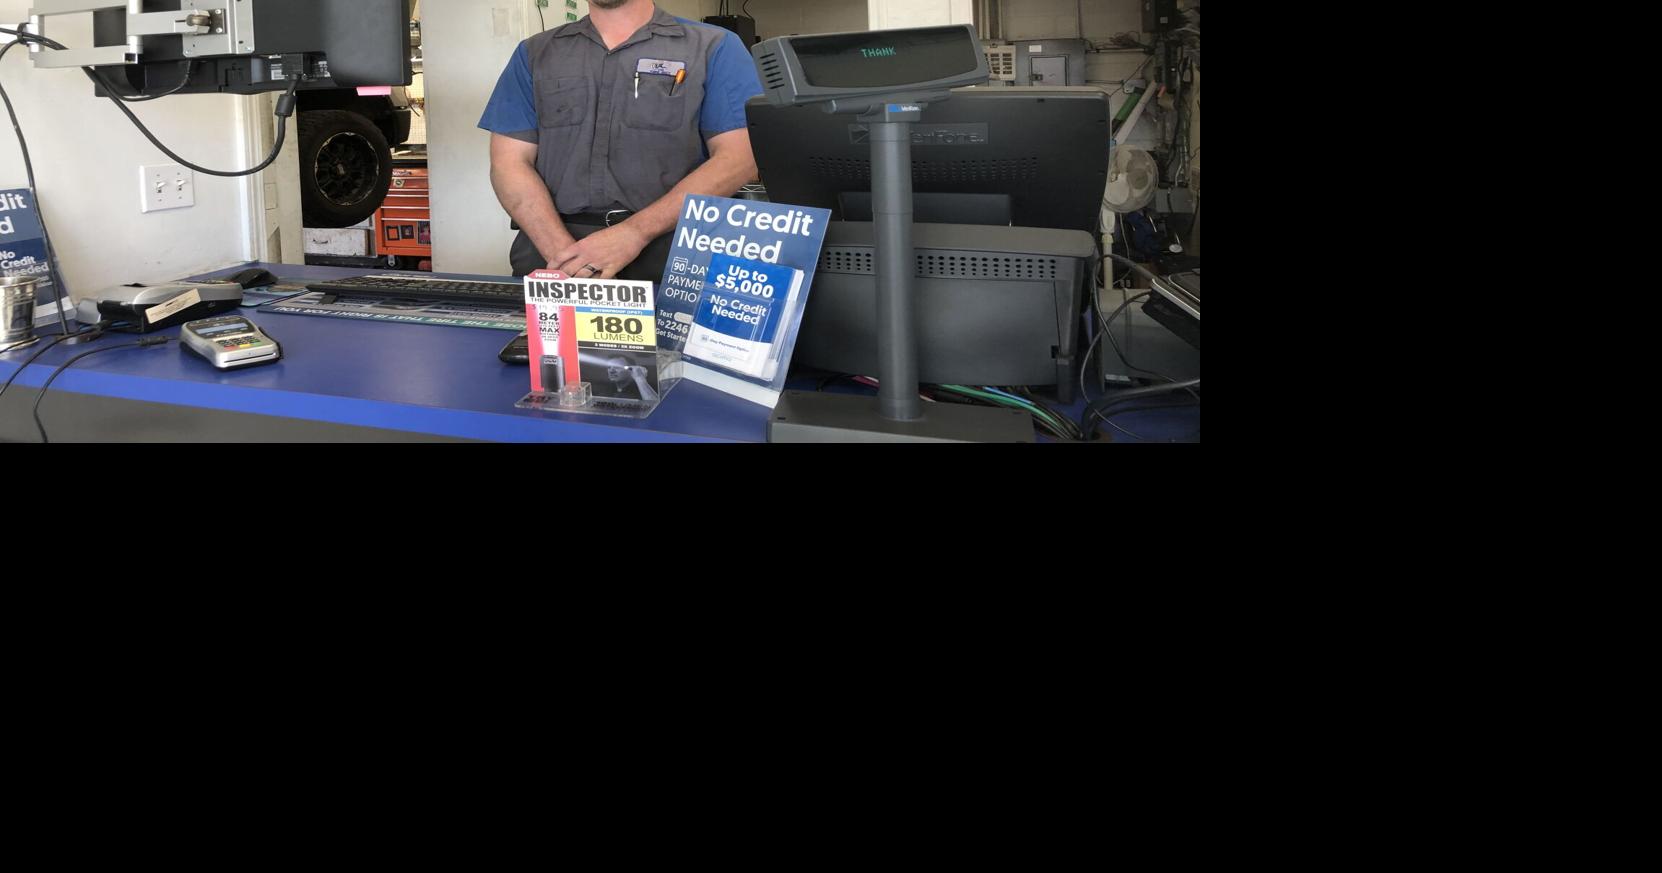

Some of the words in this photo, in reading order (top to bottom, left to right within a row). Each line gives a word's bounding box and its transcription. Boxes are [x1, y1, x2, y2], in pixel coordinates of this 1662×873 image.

[861, 46, 897, 58] THANK
[685, 199, 720, 223] No
[726, 204, 813, 237] Credit
[677, 227, 782, 264] Needed
[0, 250, 15, 260] No
[0, 255, 36, 269] Credit
[4, 262, 49, 277] Needed
[729, 264, 750, 280] Up
[752, 270, 768, 282] to
[528, 281, 647, 303] INSPECTOR
[715, 273, 774, 298] $5,000
[547, 298, 588, 306] POWERFUL
[665, 287, 698, 302] OPTIO
[709, 294, 728, 306] No
[730, 299, 767, 316] Credit
[539, 312, 559, 321] 84
[659, 309, 673, 319] Text
[711, 305, 760, 325] Needed
[590, 316, 643, 335] 180
[657, 318, 665, 326] To
[664, 320, 688, 334] 2246
[593, 333, 644, 342] LUMENS
[655, 328, 666, 336] Get
[667, 331, 687, 342] Starte
